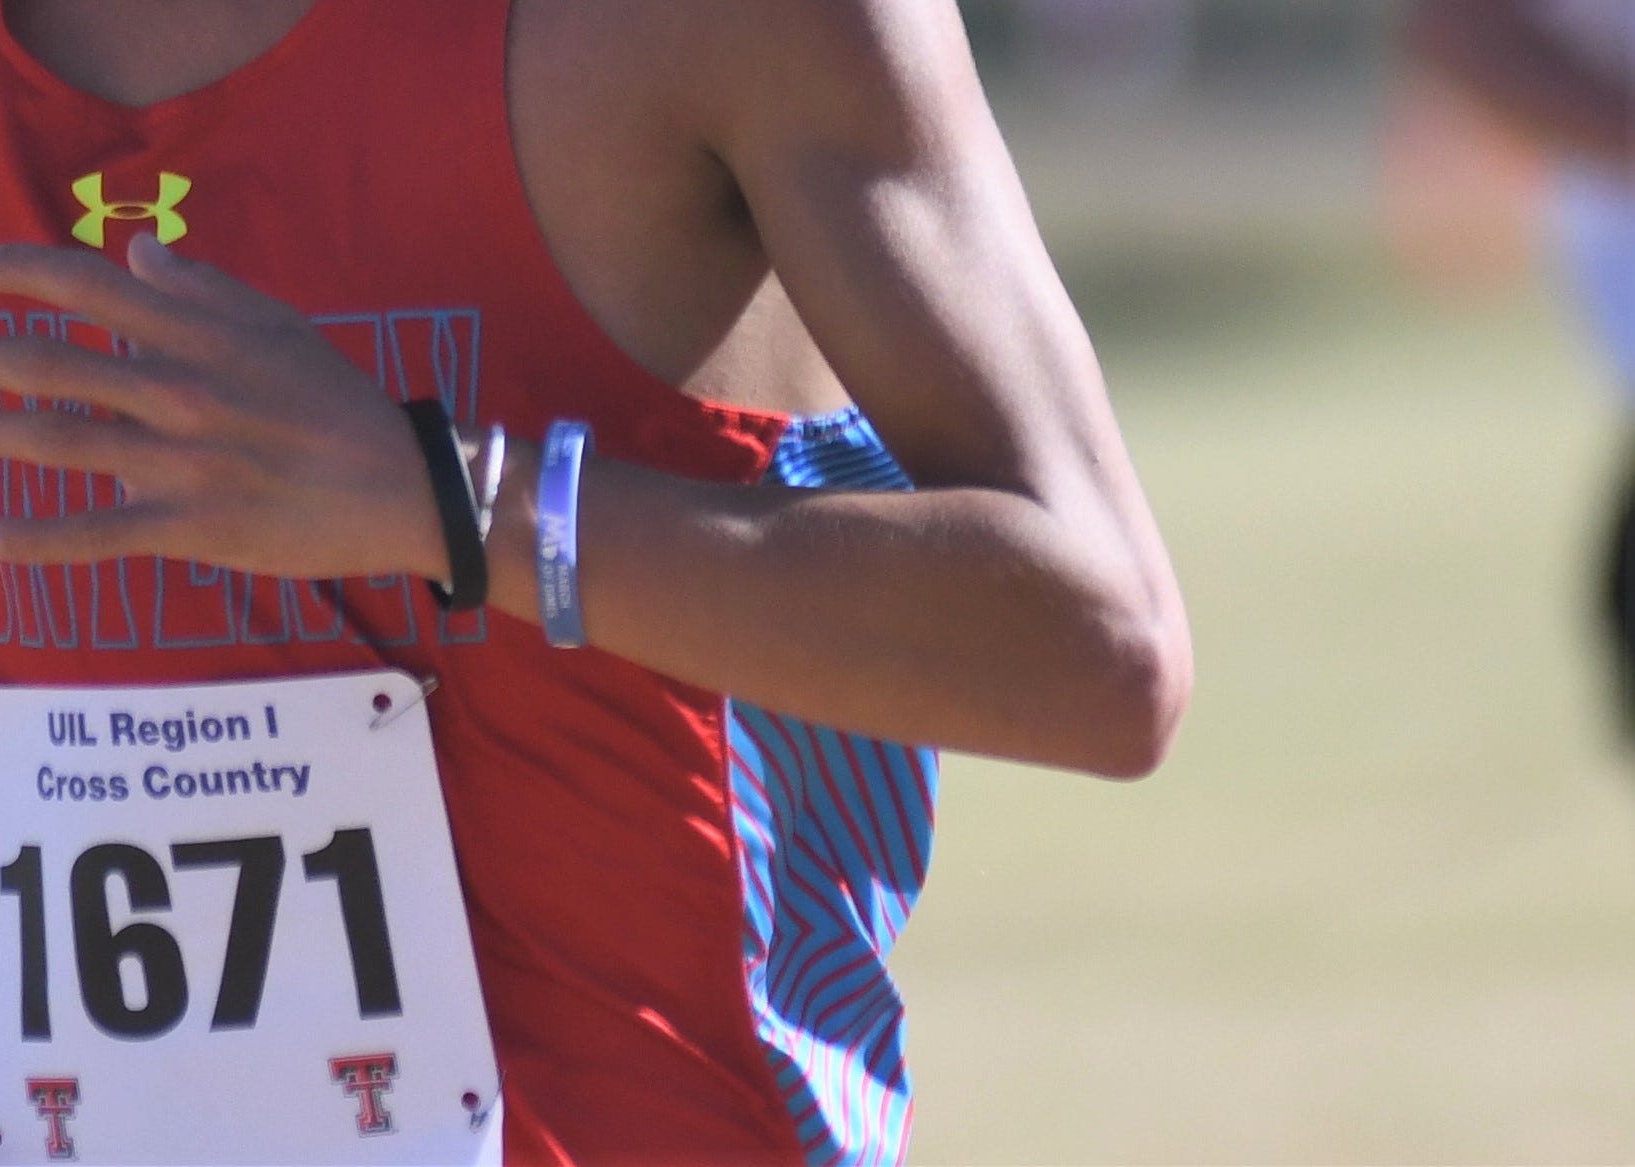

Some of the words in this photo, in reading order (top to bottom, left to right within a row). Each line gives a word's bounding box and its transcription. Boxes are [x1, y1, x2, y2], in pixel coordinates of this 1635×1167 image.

[48, 712, 97, 746] UIL
[109, 711, 251, 752] Region
[265, 705, 278, 739] I
[37, 766, 129, 801] Cross
[142, 762, 311, 800] Country
[0, 827, 403, 1043] 1671
